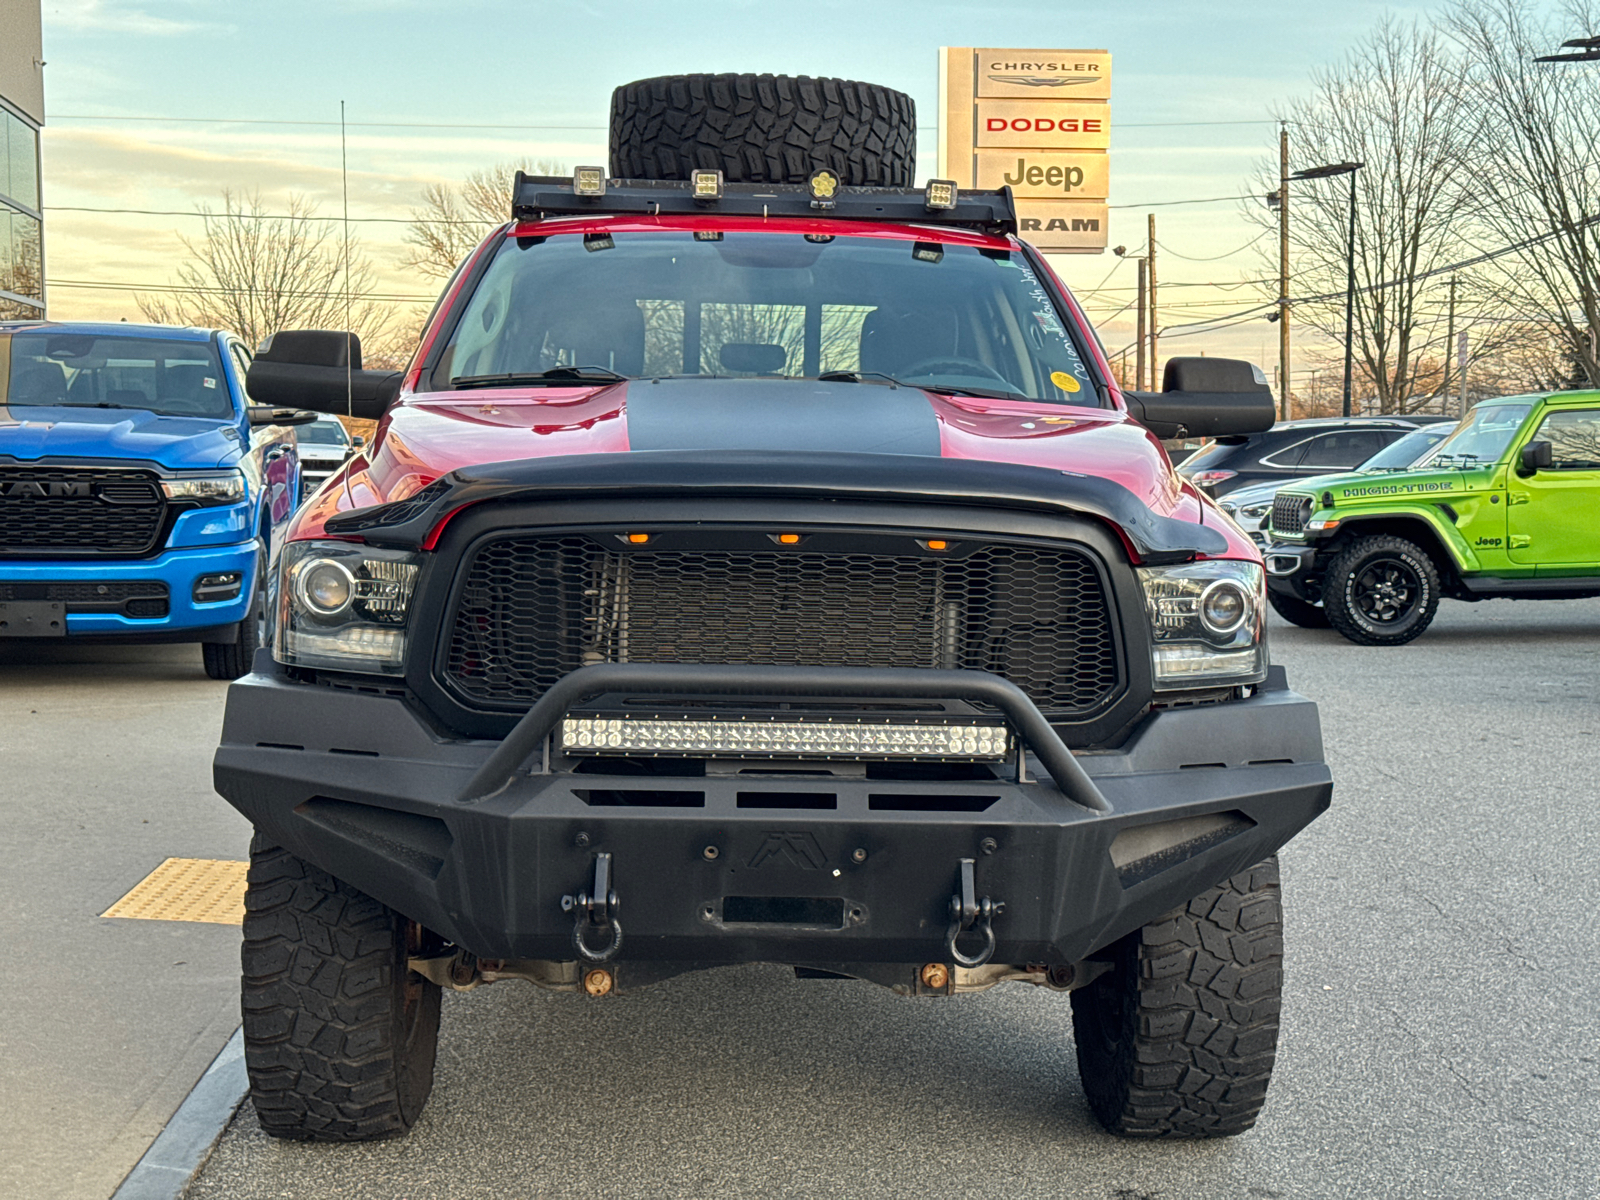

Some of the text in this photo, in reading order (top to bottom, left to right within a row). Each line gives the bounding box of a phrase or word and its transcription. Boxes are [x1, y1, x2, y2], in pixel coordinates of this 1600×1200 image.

[990, 62, 1100, 72] CHRYSLER
[986, 118, 1102, 133] DODGE
[1004, 158, 1084, 192] Jeep
[1020, 218, 1100, 232] RAM
[0, 481, 91, 497] AM
[1475, 537, 1502, 547] Jeep
[1400, 553, 1430, 607] DESTINATION
